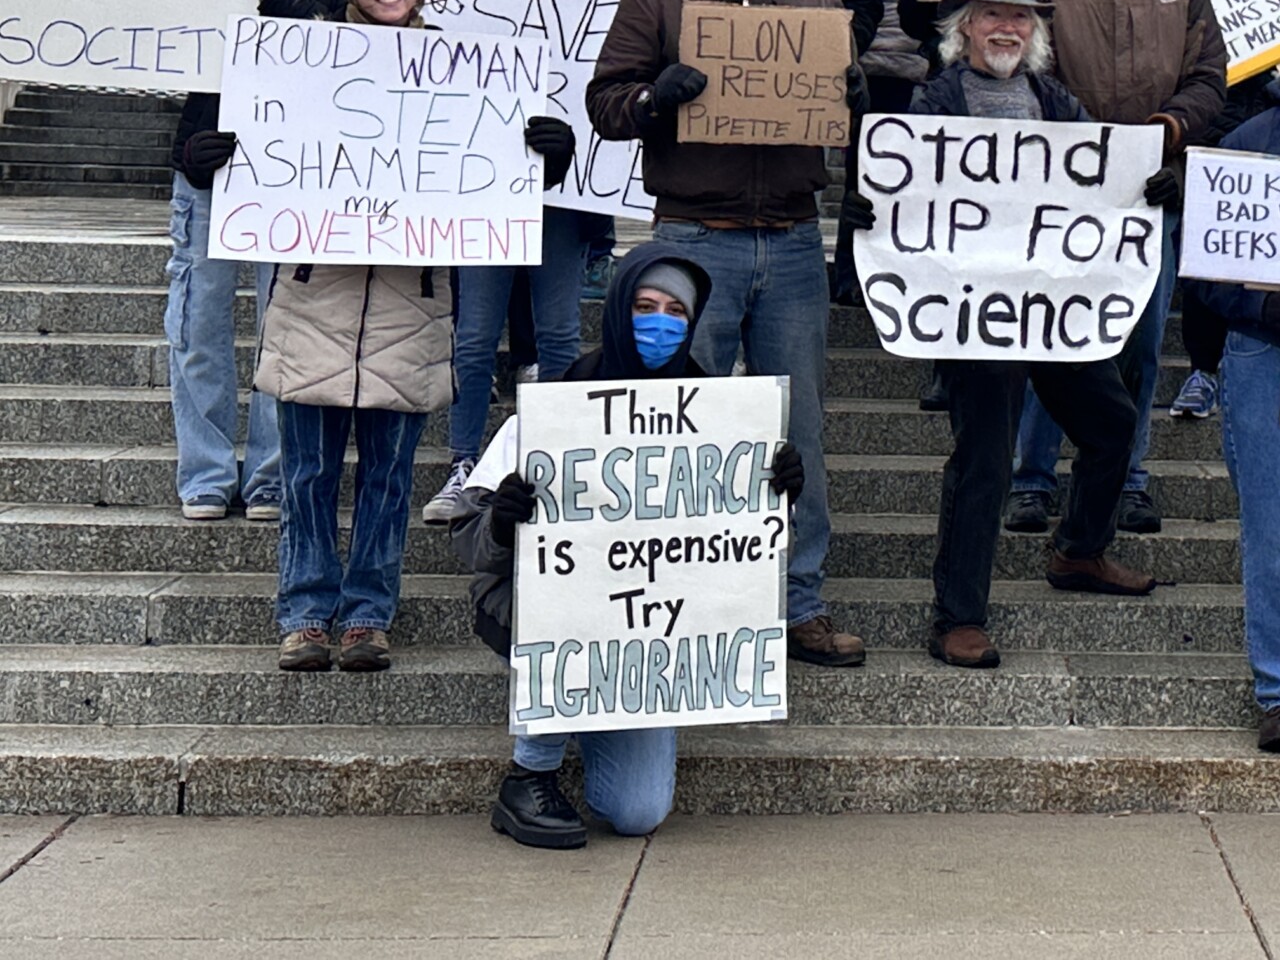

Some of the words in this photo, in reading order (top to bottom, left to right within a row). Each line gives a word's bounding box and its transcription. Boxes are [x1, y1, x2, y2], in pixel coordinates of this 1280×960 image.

[0, 17, 227, 76] SOCIET
[232, 17, 371, 69] PROUD
[396, 31, 543, 94] WOMAN
[696, 16, 807, 65] ELON
[720, 64, 845, 103] REUSES
[254, 94, 285, 123] in
[332, 77, 530, 159] STEM
[686, 102, 791, 139] PIPETTE
[224, 137, 496, 195] ASHAMED
[509, 163, 539, 194] of
[862, 117, 1113, 195] Stand
[1202, 166, 1253, 195] YOU
[220, 202, 541, 262] GOVERNMENT
[344, 195, 398, 226] my
[890, 198, 991, 253] UP
[1027, 204, 1155, 267] FOR
[1216, 200, 1270, 223] BAD
[1203, 228, 1278, 261] GEEKS
[863, 272, 1135, 351] Science
[525, 441, 785, 525] RESEARCH
[537, 534, 576, 576] is
[607, 515, 785, 583] expensive?
[609, 588, 685, 638] Try
[514, 627, 783, 722] IGNORANCE
